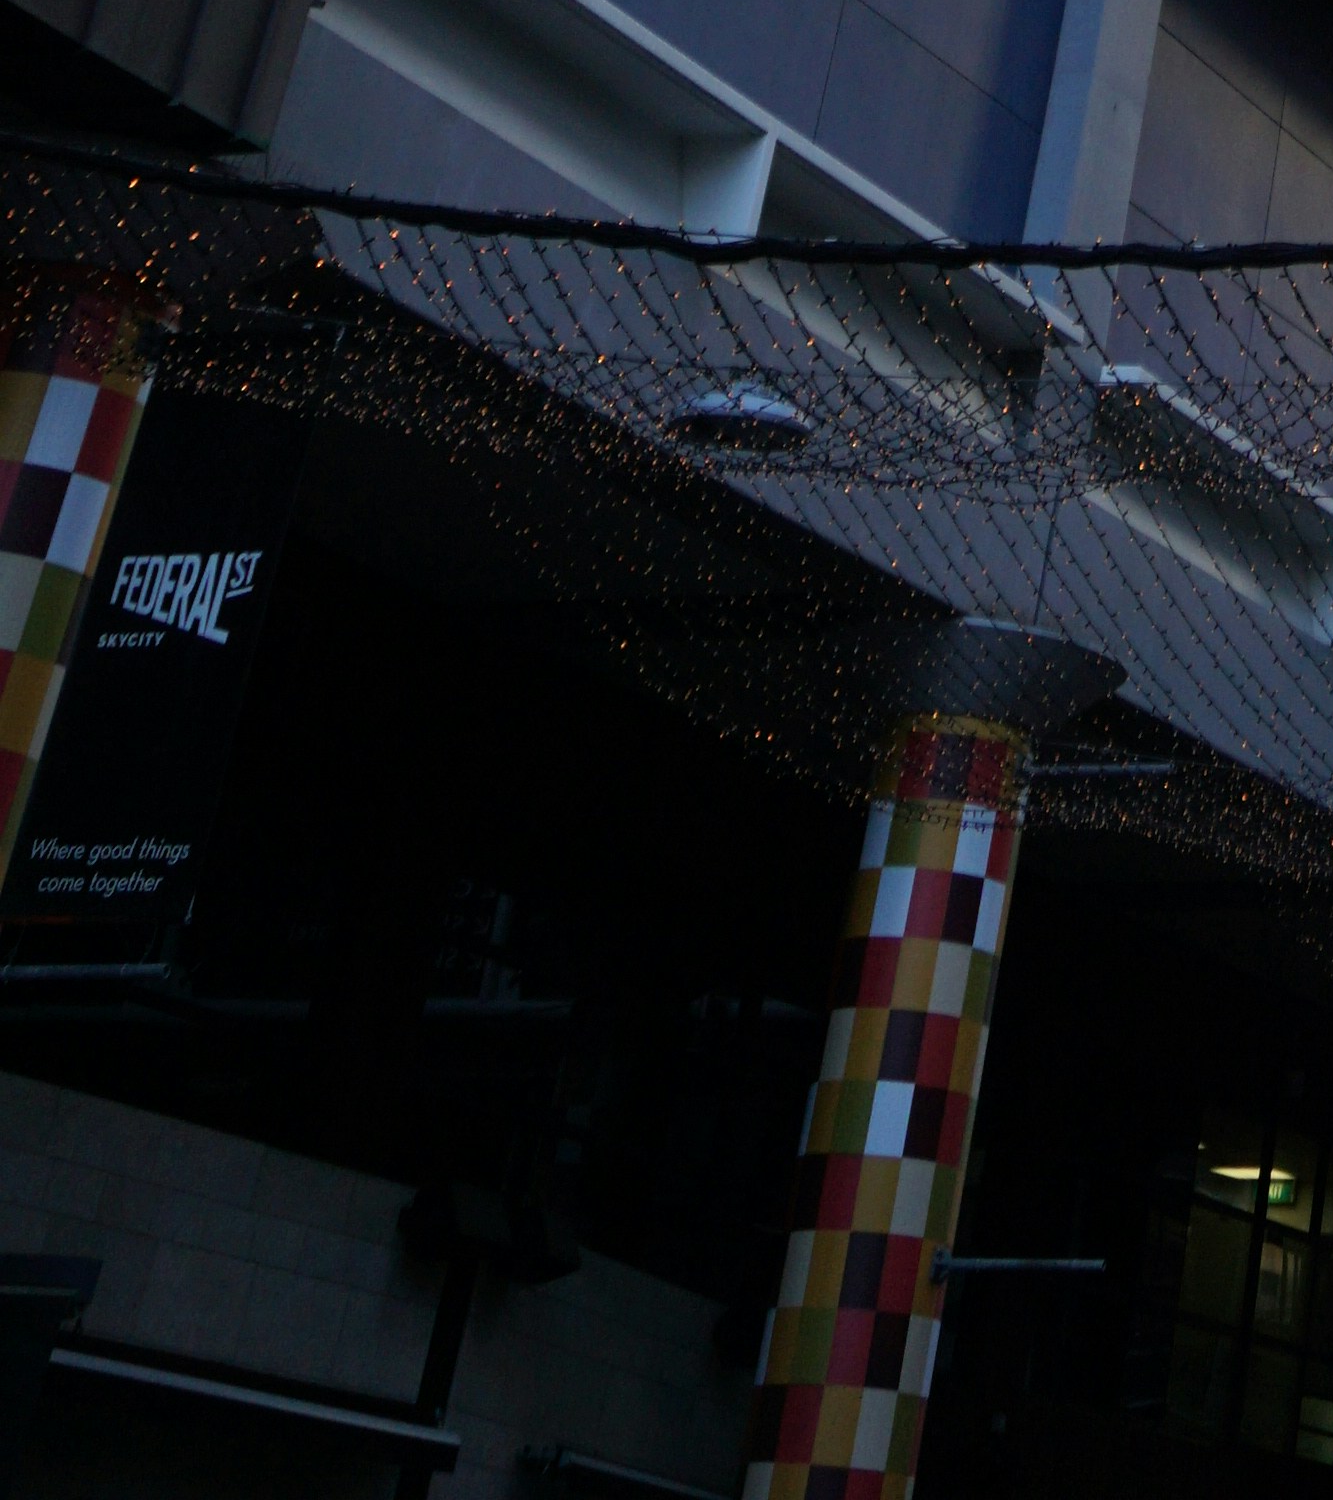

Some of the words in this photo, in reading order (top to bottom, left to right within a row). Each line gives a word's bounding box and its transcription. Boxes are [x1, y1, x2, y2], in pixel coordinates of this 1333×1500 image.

[110, 551, 233, 645] FEDERAL
[231, 550, 264, 589] ST
[97, 630, 167, 649] SKYCITY
[30, 836, 84, 862] Where
[87, 836, 138, 865] good
[139, 835, 191, 866] things
[38, 873, 85, 893] come
[90, 869, 164, 898] together
